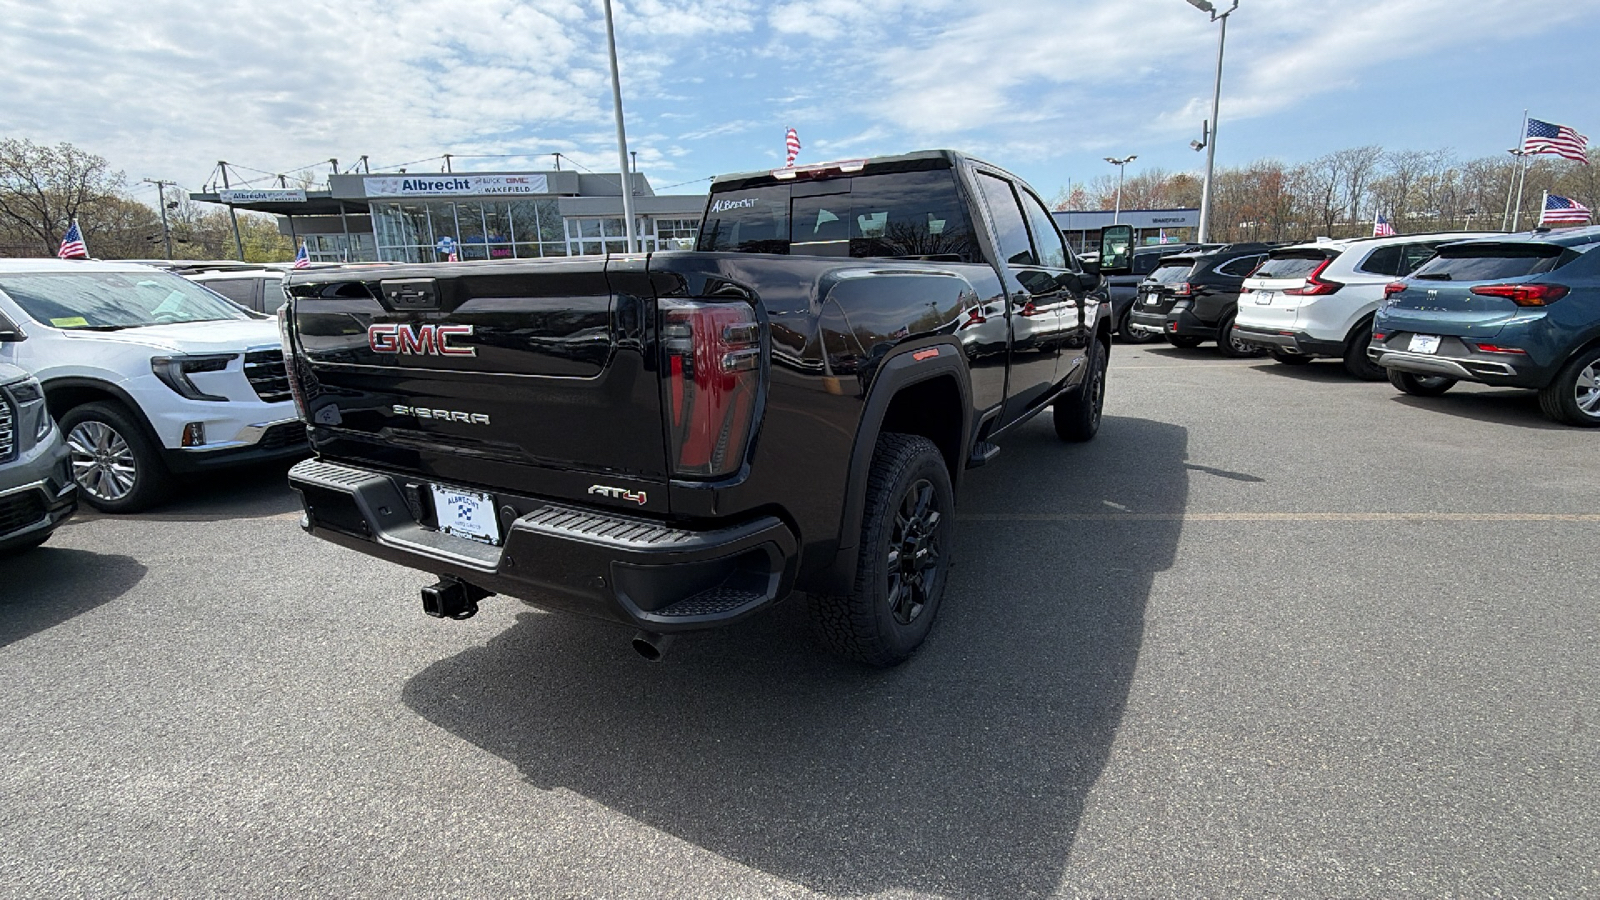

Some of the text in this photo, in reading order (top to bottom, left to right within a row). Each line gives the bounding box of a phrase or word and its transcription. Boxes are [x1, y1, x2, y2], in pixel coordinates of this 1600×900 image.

[402, 178, 470, 191] Albrecht
[368, 323, 477, 358] GMC
[392, 404, 491, 426] SIERRA
[587, 484, 648, 506] AT4
